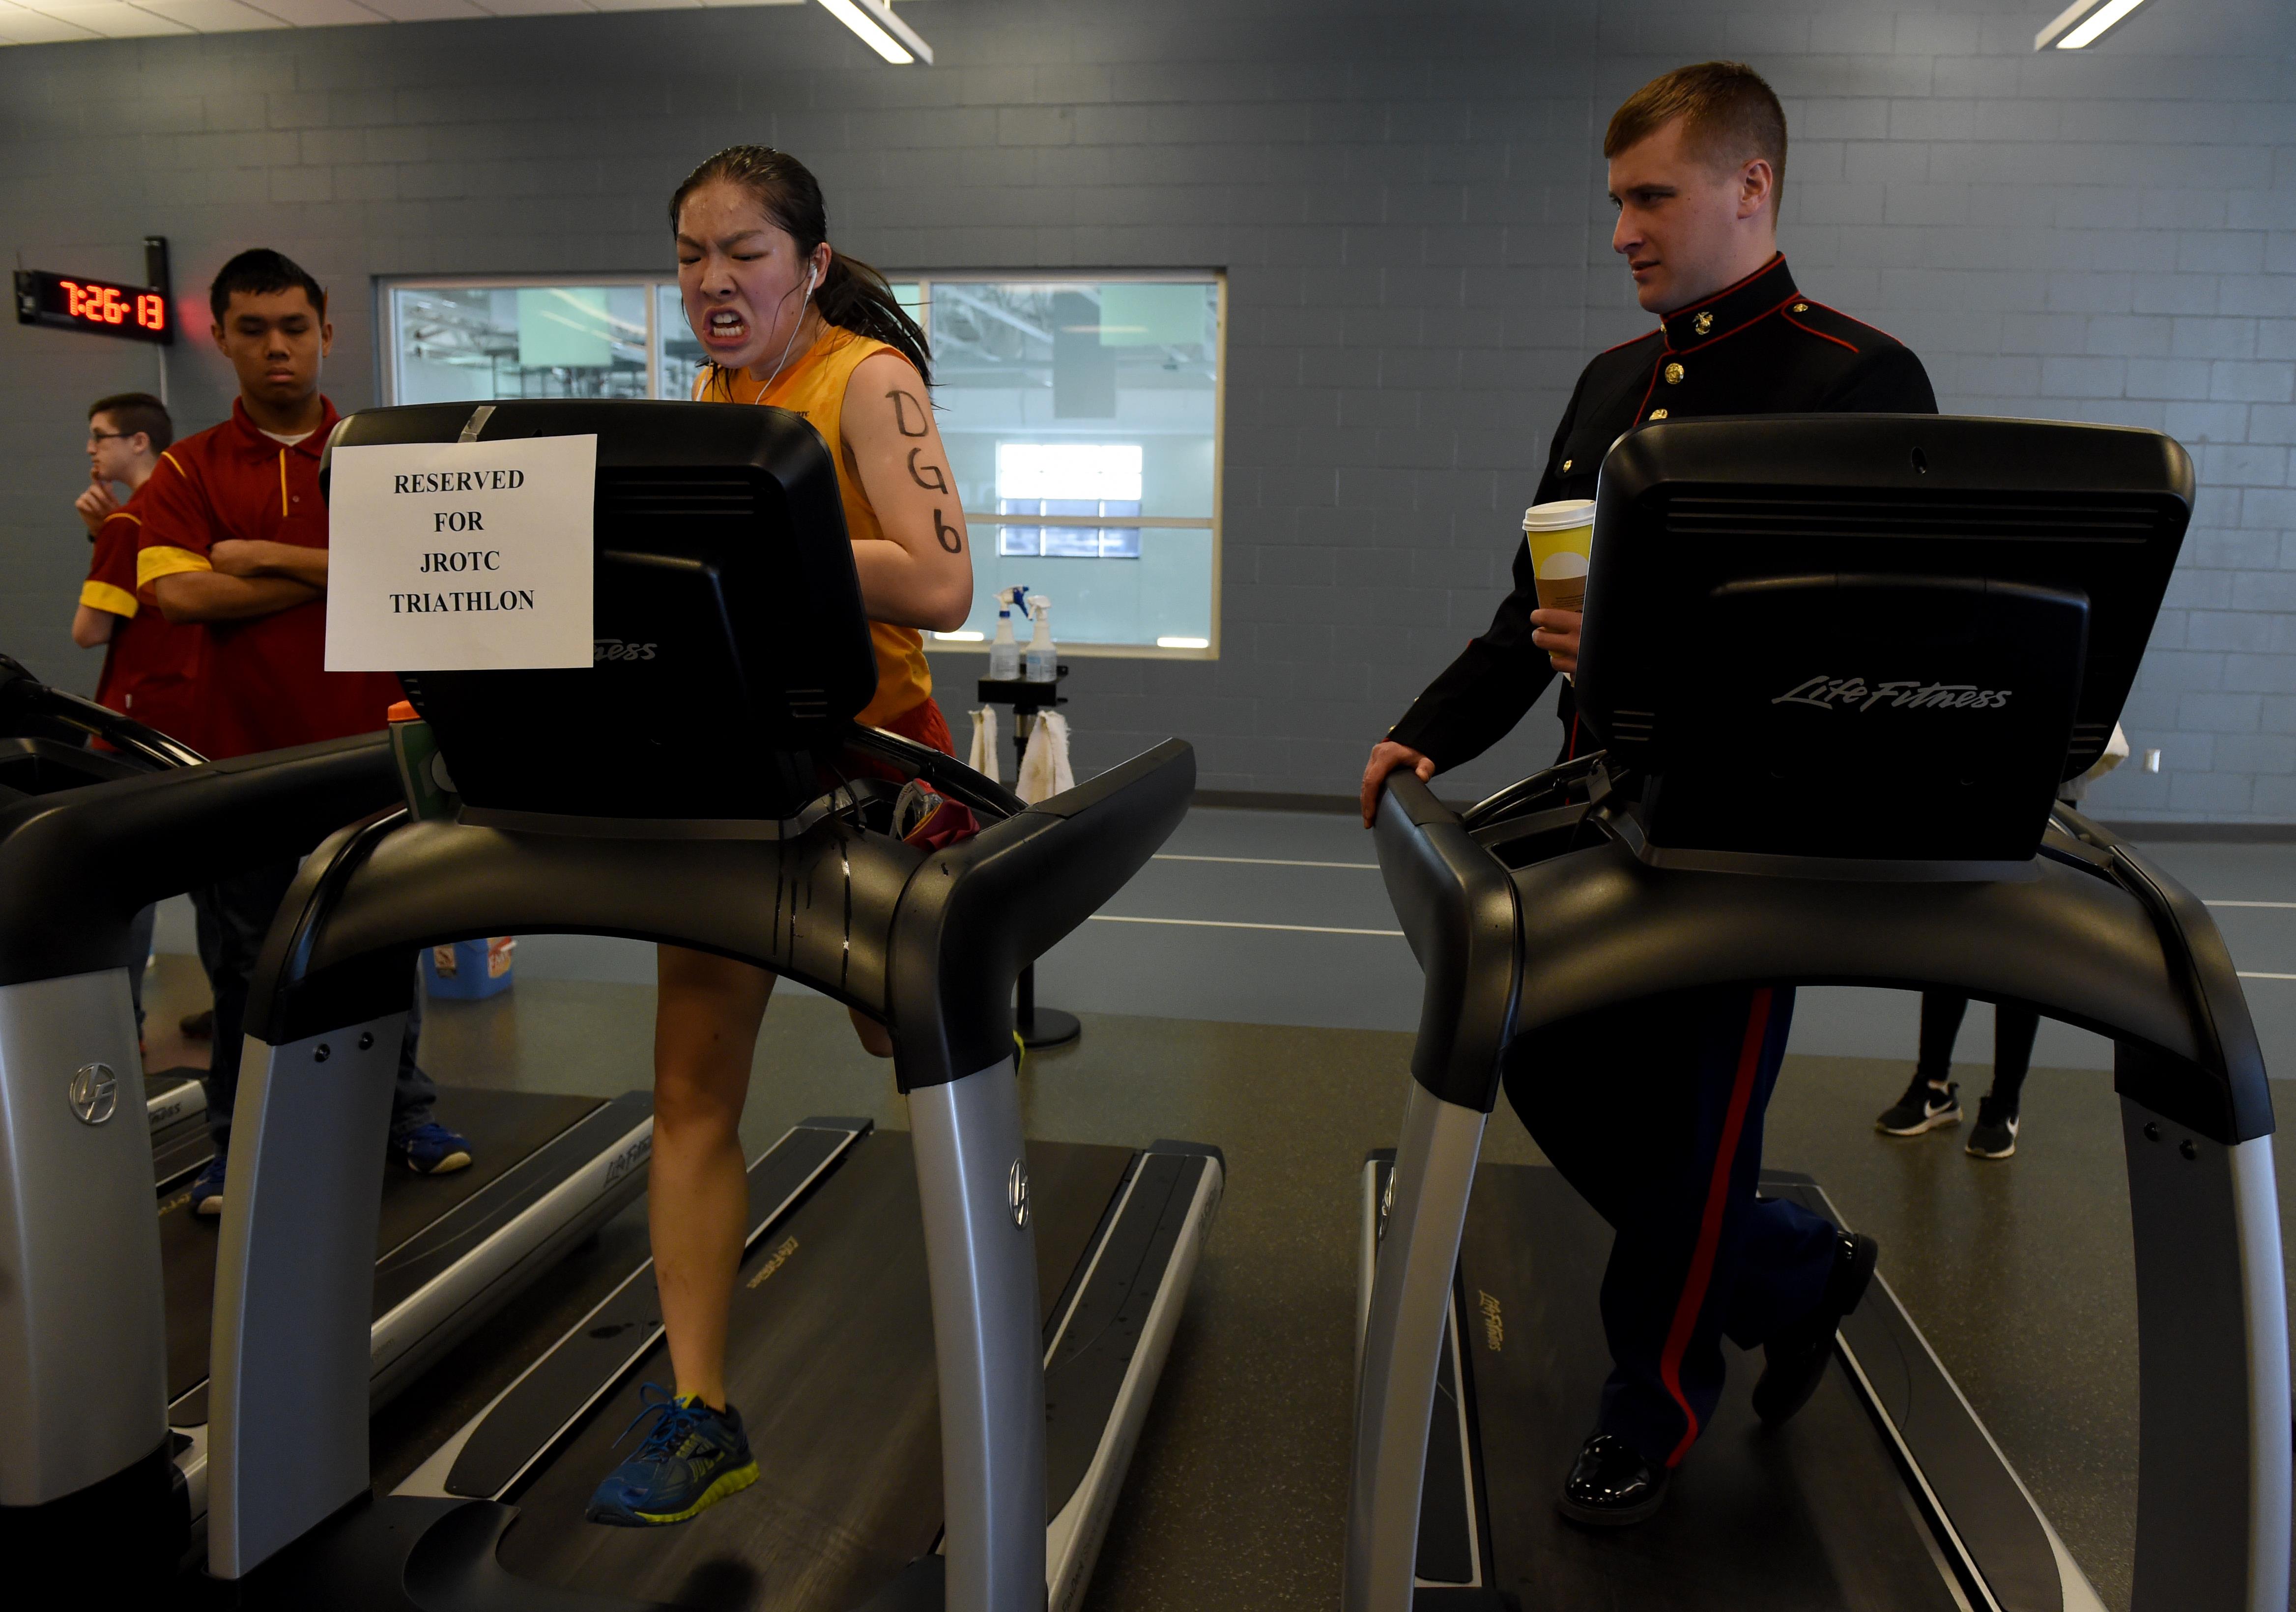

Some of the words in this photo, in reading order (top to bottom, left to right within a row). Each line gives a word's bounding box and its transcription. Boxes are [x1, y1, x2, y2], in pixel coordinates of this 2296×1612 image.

[394, 470, 524, 494] RESERVED
[434, 511, 485, 532] FOR
[420, 550, 500, 573] JROTC
[389, 590, 535, 613] TRIATHLON
[1771, 675, 1867, 710] Life
[1860, 681, 2012, 712] Fitness
